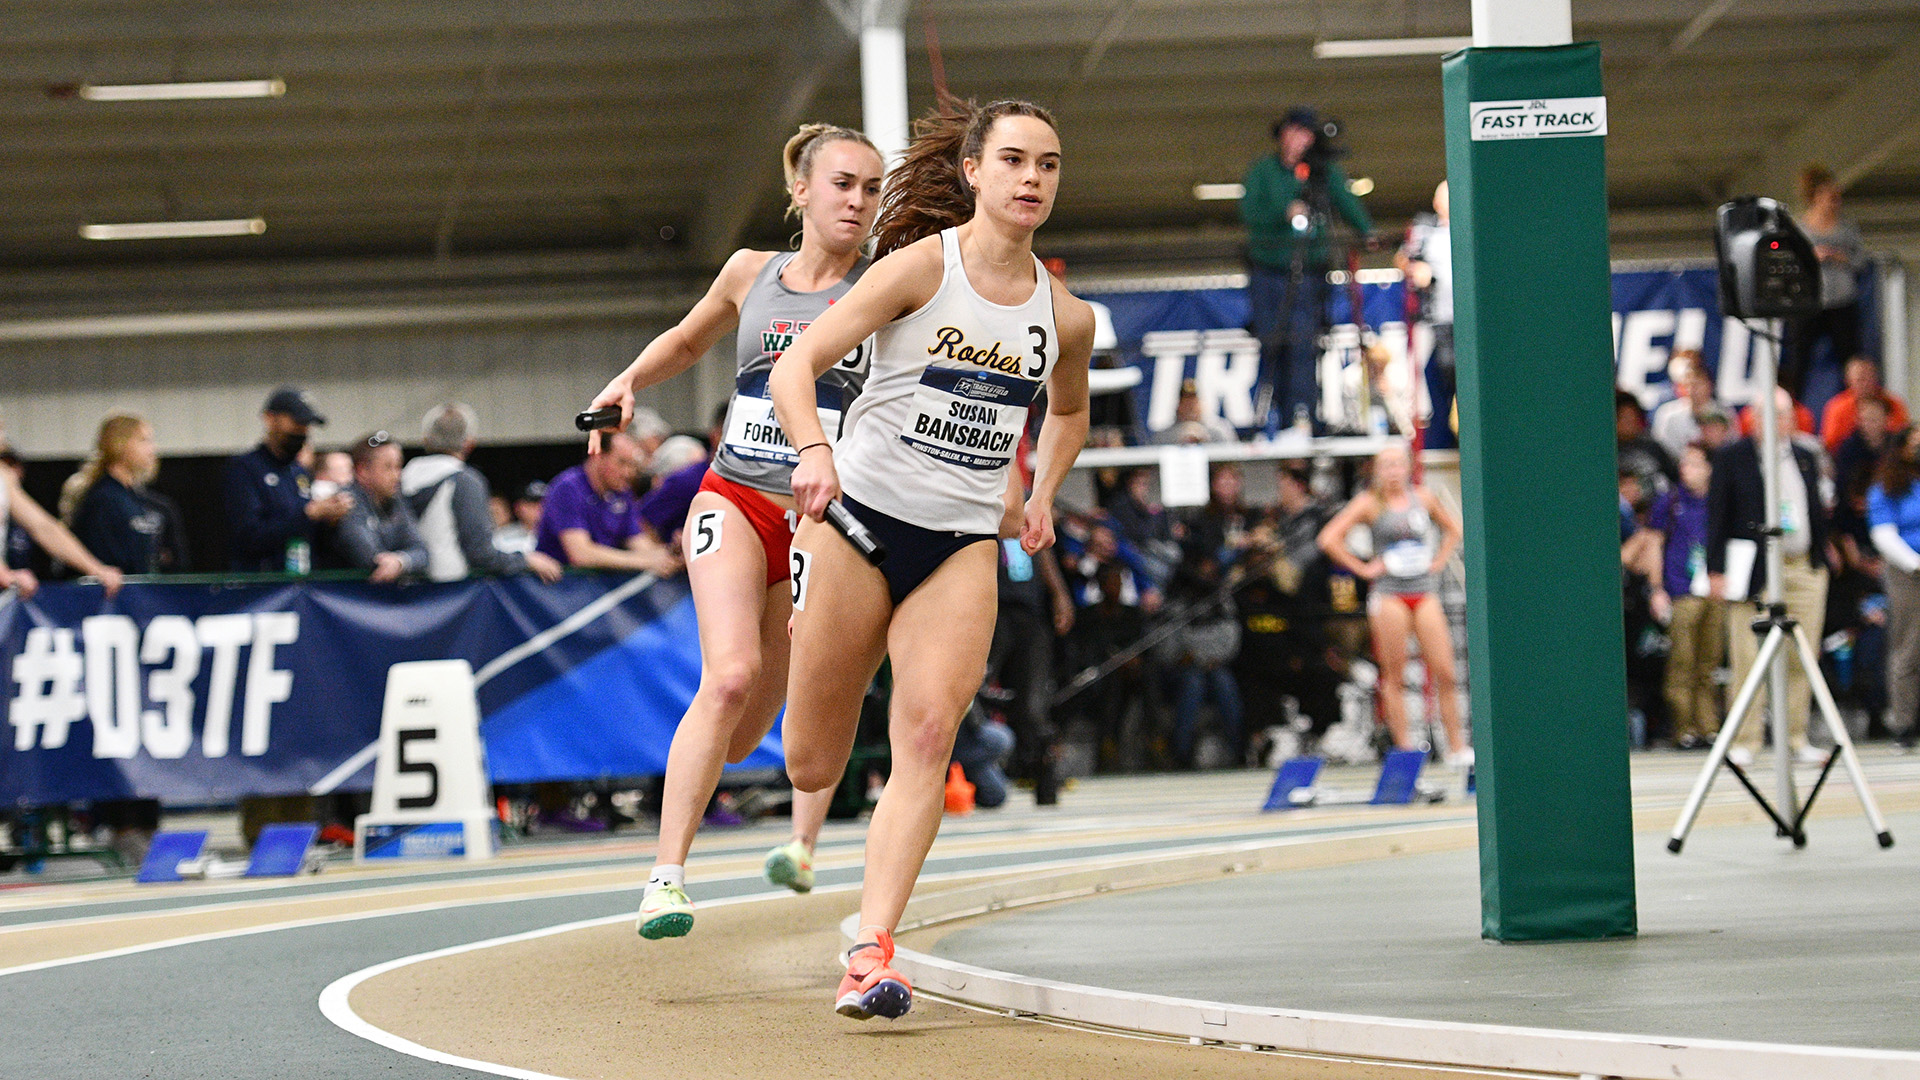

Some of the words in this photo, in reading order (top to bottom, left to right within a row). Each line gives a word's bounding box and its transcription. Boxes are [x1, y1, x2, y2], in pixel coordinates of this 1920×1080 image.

[1482, 114, 1528, 129] FAST
[1533, 111, 1596, 127] TRACK
[927, 326, 1024, 376] Roches
[1027, 324, 1047, 378] 3
[743, 422, 792, 448] FORM
[914, 413, 1015, 453] BANSBACH
[948, 401, 998, 426] SUSAN
[696, 513, 716, 555] 5
[792, 552, 805, 605] 3
[9, 611, 299, 759] #D3TF
[398, 728, 439, 810] 5
